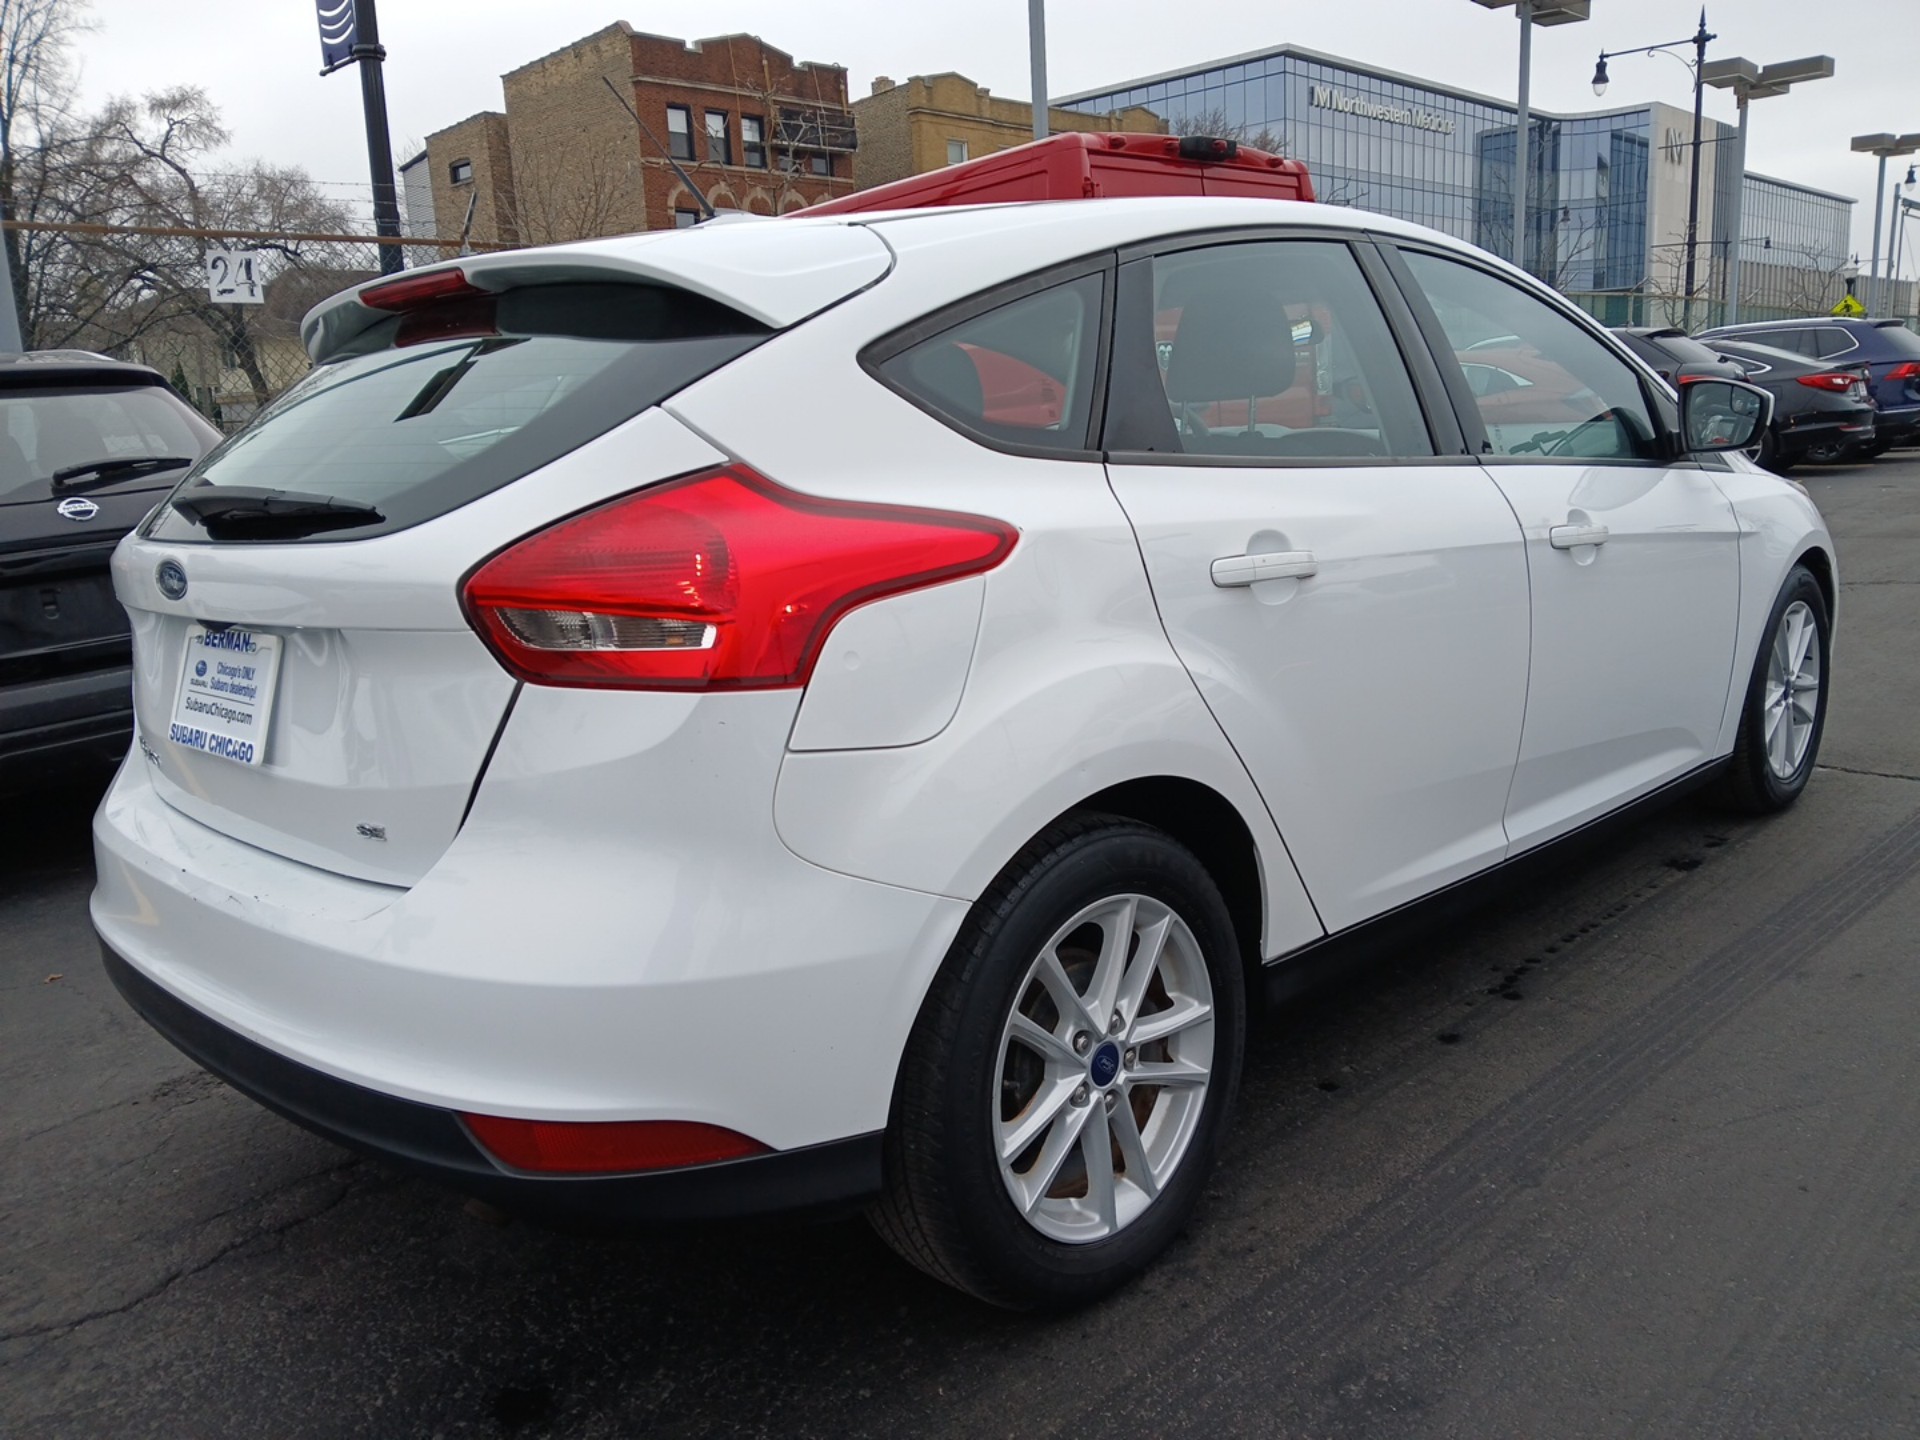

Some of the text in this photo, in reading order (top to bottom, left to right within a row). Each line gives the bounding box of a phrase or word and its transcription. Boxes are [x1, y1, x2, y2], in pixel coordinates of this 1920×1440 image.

[1333, 89, 1411, 124] Northwestern
[1412, 107, 1456, 136] Medicine
[211, 256, 257, 297] 24
[204, 630, 251, 652] BERMAN
[210, 677, 229, 693] Subaru
[217, 661, 256, 681] Chicago's ONLY
[185, 697, 253, 725] SubaruChicago.com
[169, 723, 254, 763] SUBARU CHICAGO
